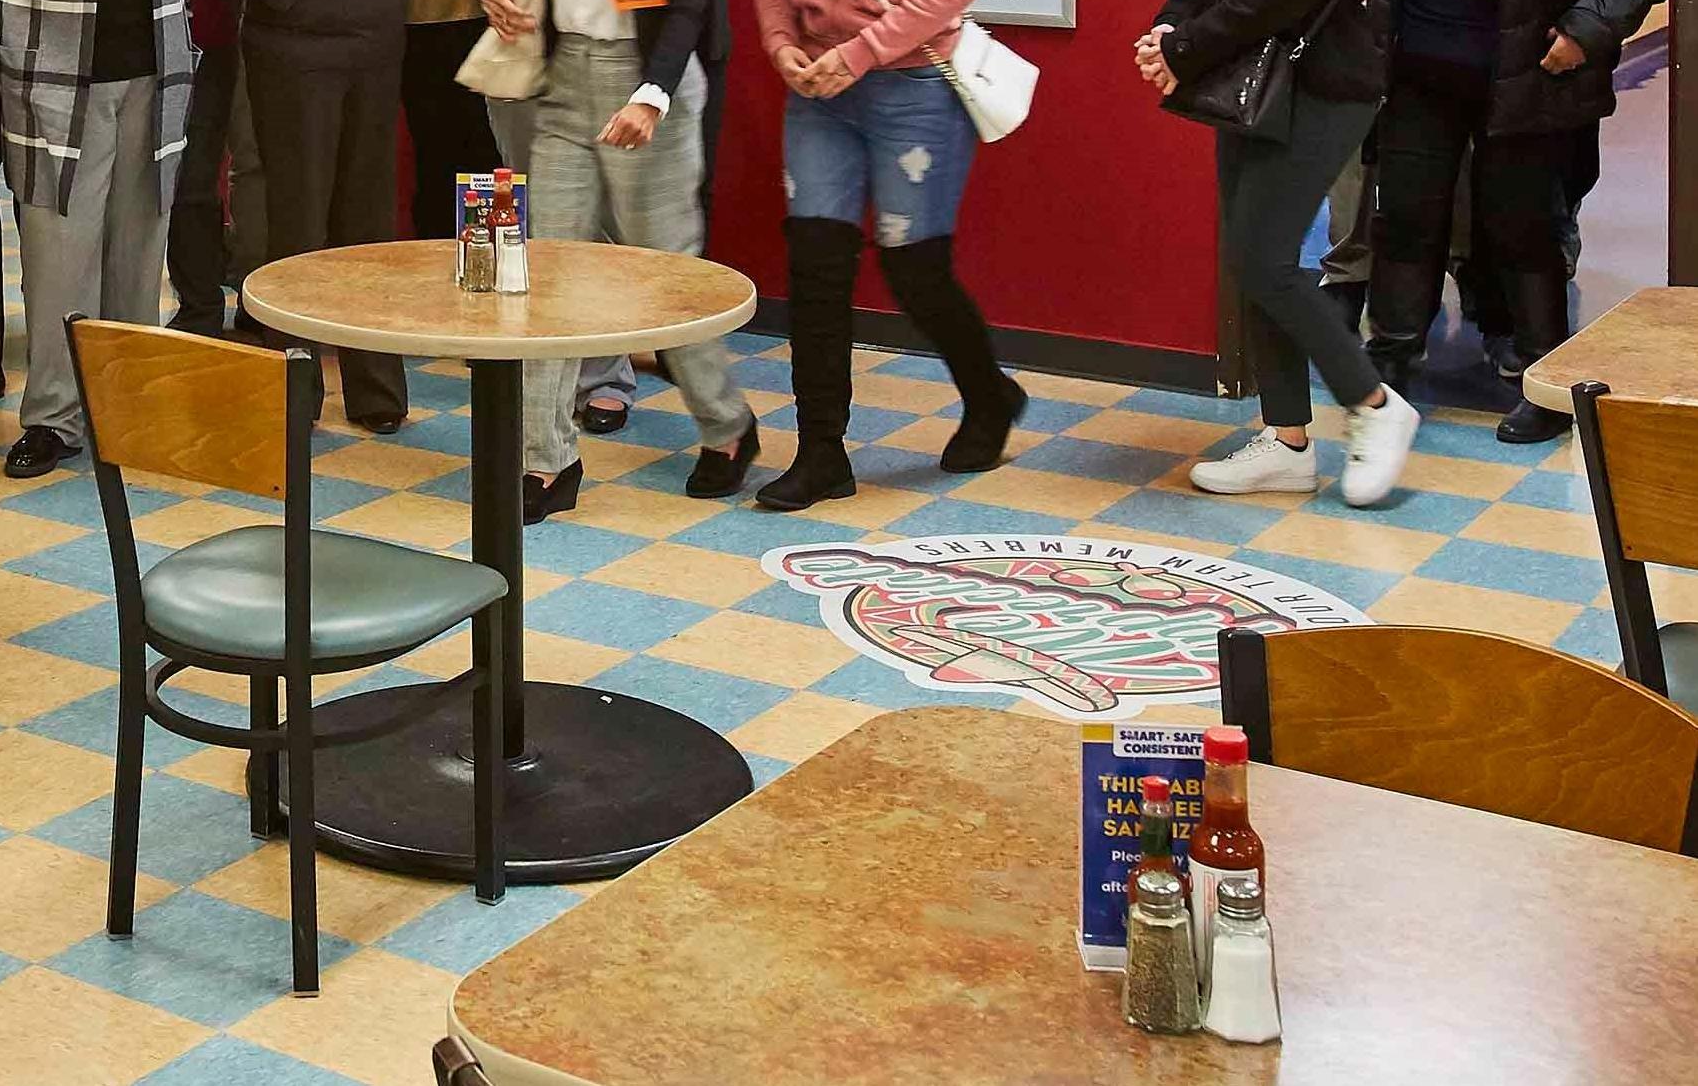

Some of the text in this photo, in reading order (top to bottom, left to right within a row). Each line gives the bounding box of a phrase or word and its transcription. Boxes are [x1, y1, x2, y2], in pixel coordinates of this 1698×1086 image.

[915, 539, 1349, 624] OUR TEAM MEMBERS
[1120, 730, 1165, 742] SMART
[1123, 743, 1202, 756] CONSISTENT
[1107, 798, 1140, 814] HA
